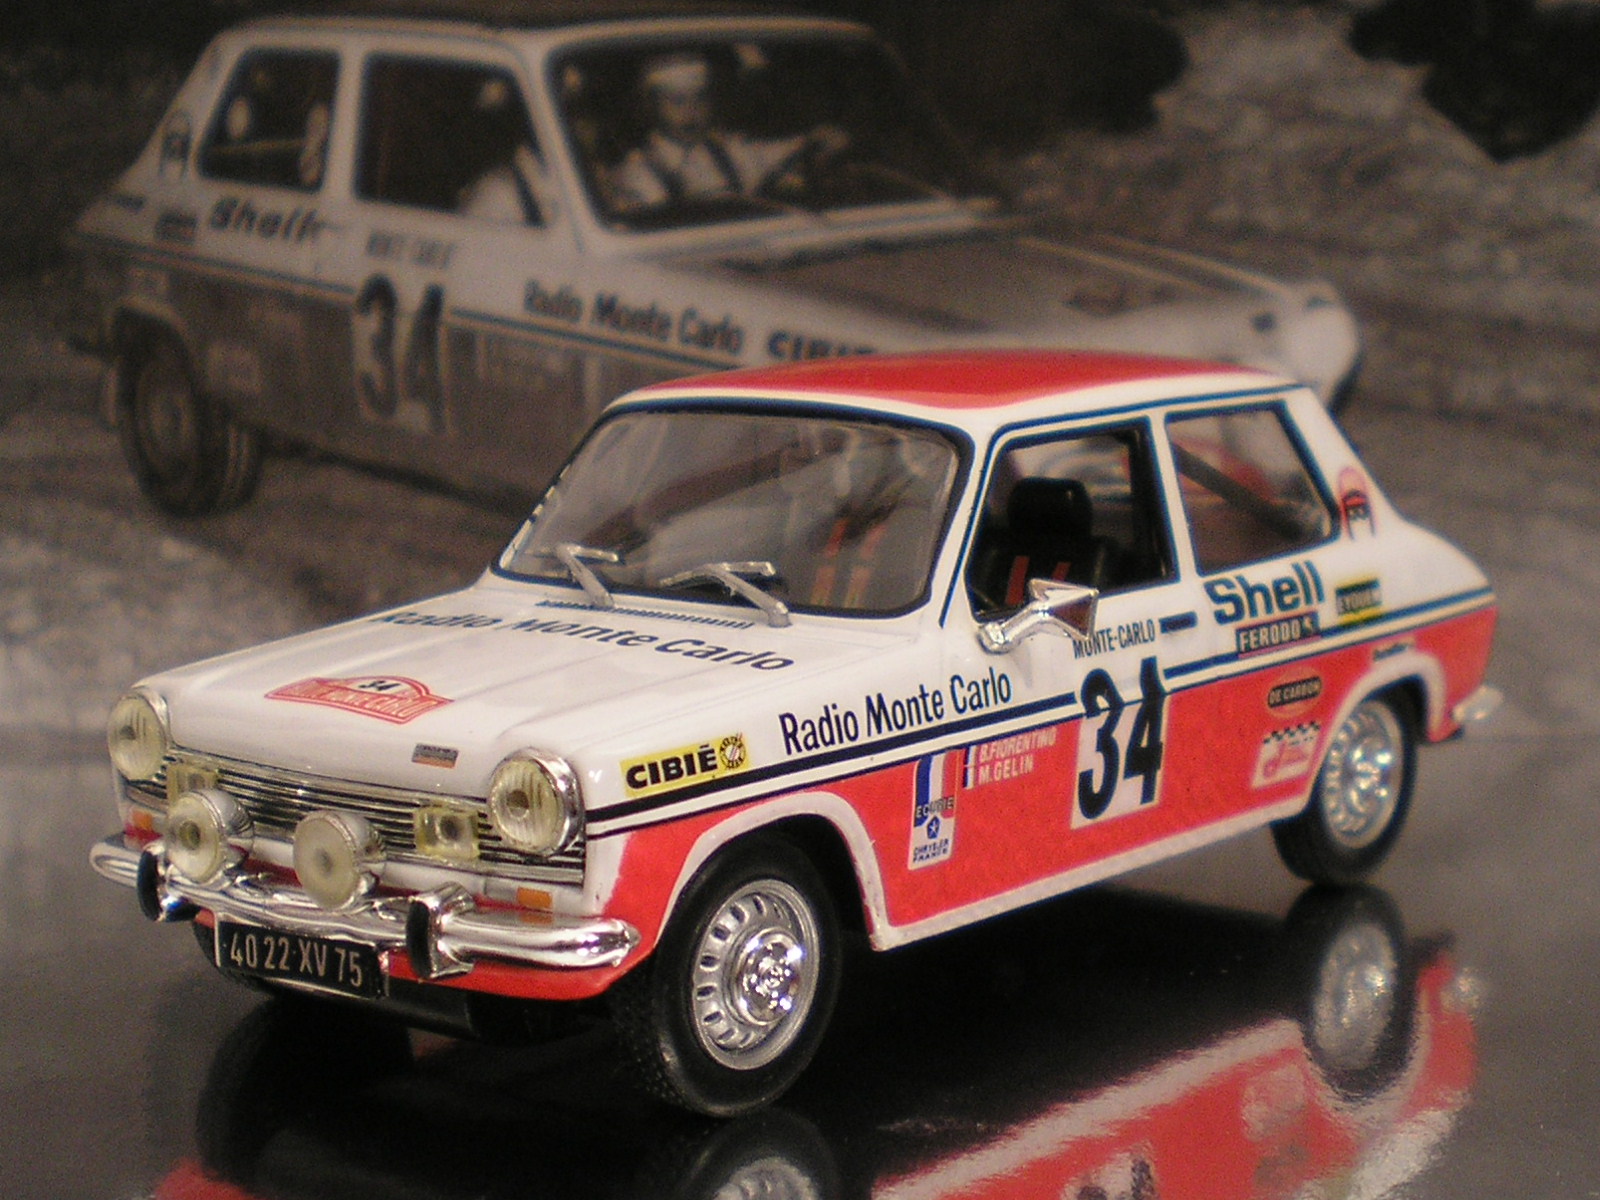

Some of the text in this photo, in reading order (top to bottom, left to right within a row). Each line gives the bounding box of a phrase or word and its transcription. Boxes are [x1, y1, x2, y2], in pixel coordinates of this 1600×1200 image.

[357, 273, 446, 430] 34
[1204, 561, 1325, 625] Shell
[496, 618, 659, 646] Monte
[655, 639, 795, 670] Carlo
[1073, 618, 1156, 659] MONTE-CARLO
[1238, 619, 1301, 652] FERODO
[778, 703, 859, 755] Radio
[865, 684, 945, 737] Monte
[950, 666, 1012, 714] Carlo
[1078, 655, 1166, 820] 34
[626, 743, 718, 789] CIBIÉ
[299, 938, 328, 977] XV
[334, 947, 363, 988] 75
